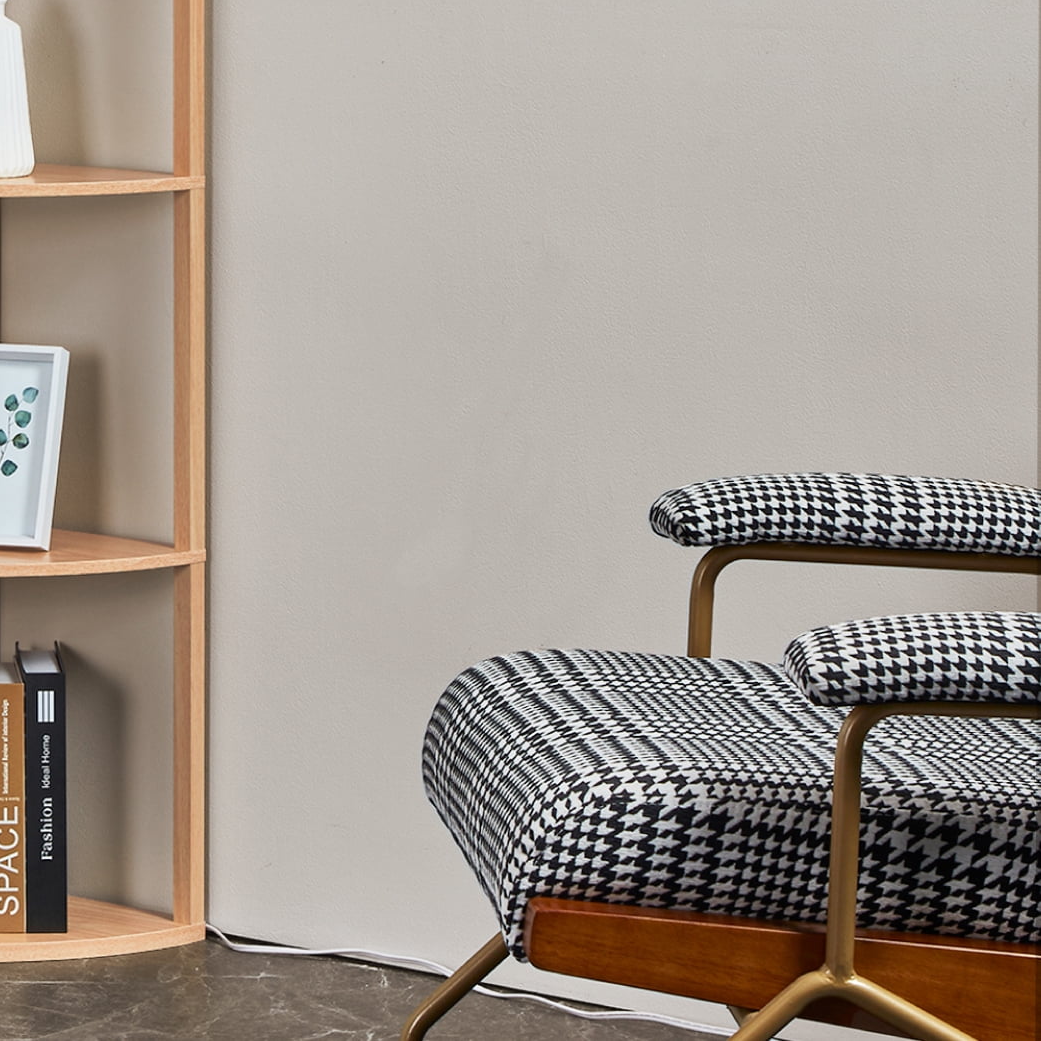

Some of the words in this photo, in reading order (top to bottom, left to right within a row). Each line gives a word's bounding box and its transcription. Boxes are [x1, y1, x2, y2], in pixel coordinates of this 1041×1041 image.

[41, 734, 51, 764] Home
[41, 765, 51, 789] Ideal
[40, 797, 53, 860] Fashion
